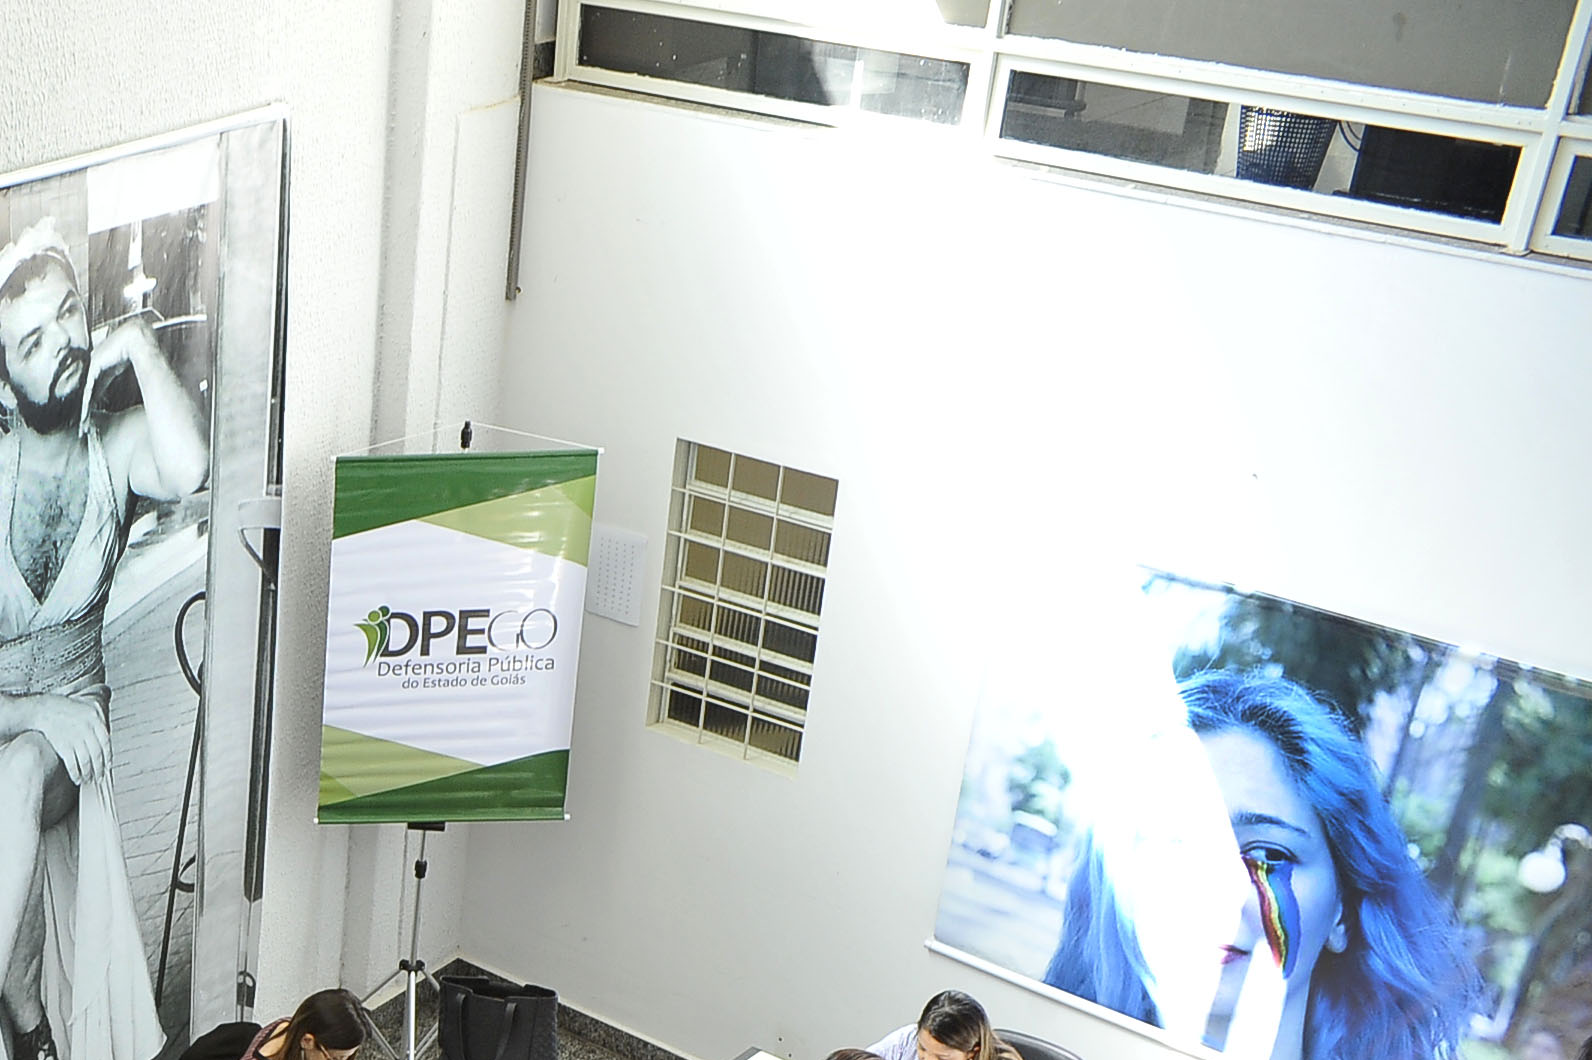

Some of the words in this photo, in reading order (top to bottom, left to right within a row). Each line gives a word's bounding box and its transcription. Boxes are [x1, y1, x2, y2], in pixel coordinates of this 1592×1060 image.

[377, 658, 481, 677] Defensoria
[488, 655, 555, 672] Pública
[402, 677, 419, 689] do
[423, 675, 467, 688] Estado
[470, 674, 487, 687] de
[491, 673, 526, 686] Goiás
